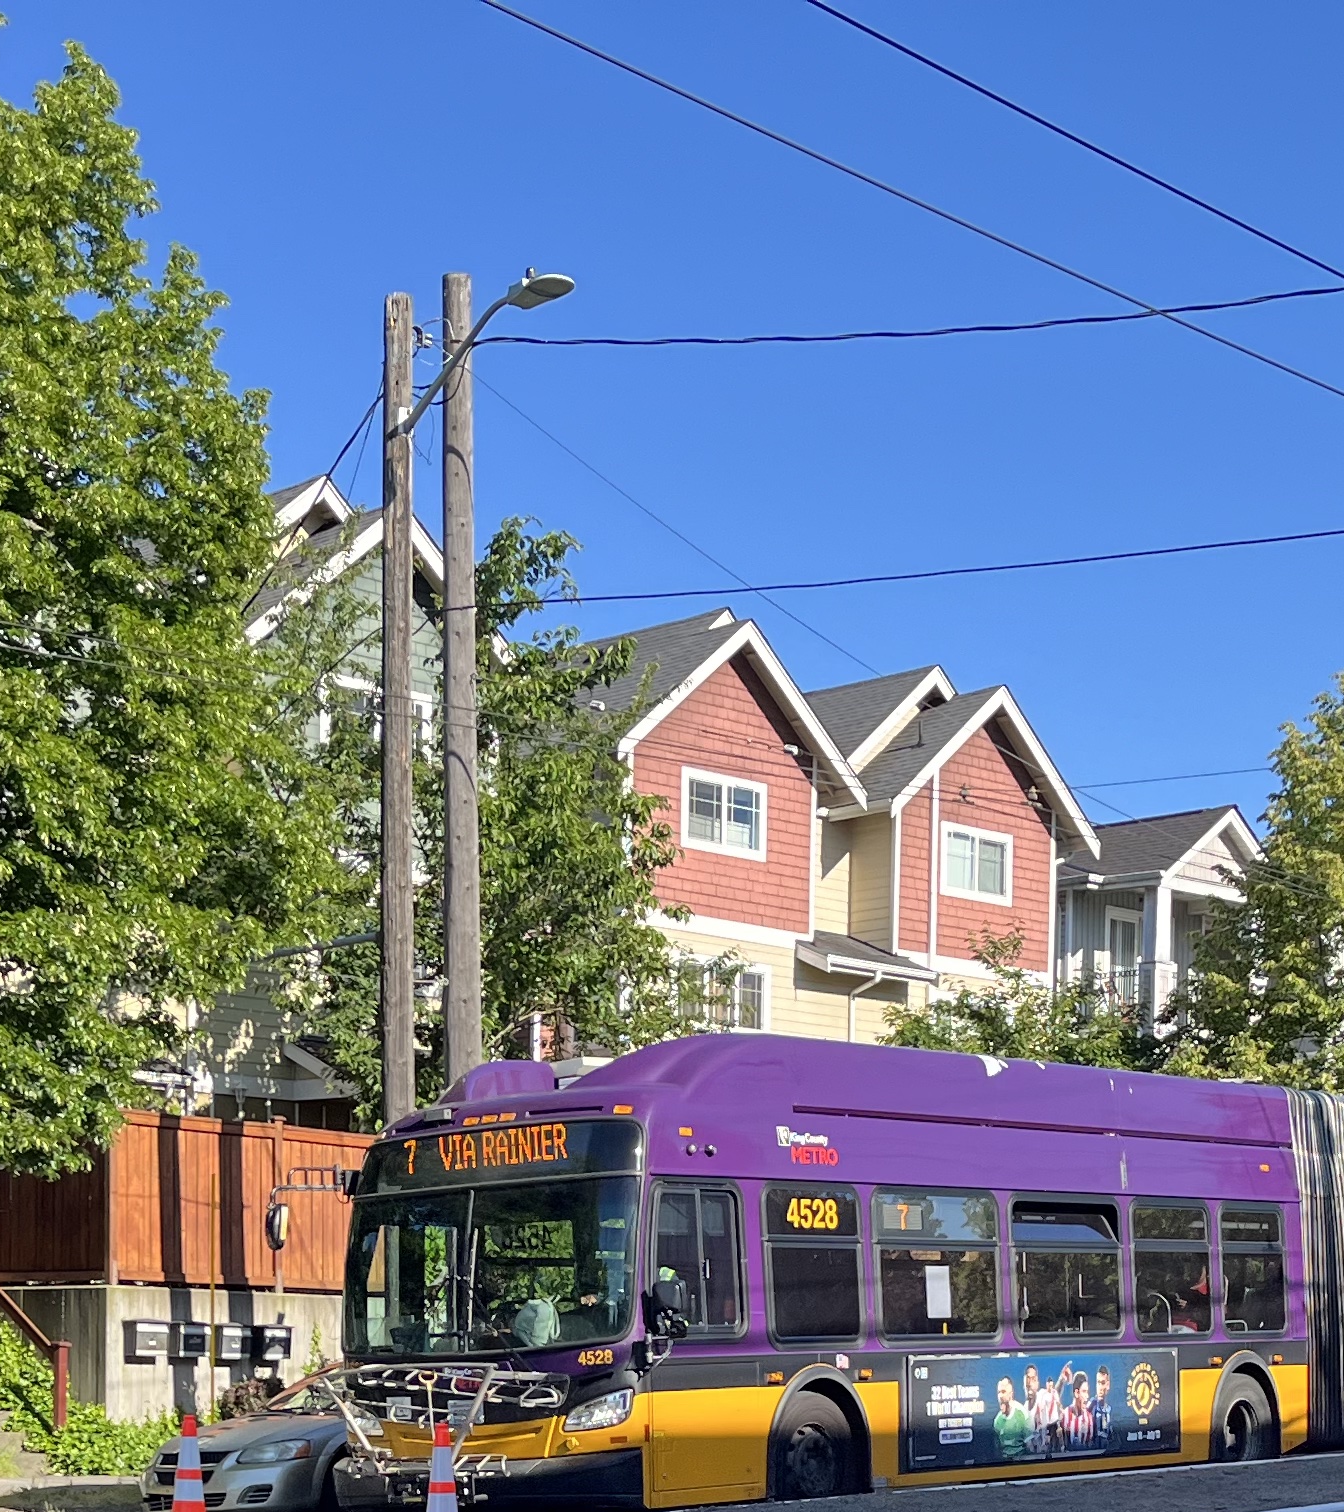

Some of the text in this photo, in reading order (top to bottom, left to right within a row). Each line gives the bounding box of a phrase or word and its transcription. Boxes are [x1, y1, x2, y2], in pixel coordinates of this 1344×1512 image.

[403, 1122, 568, 1175] 7 VIA RAINIER
[790, 1146, 839, 1167] METRO
[786, 1197, 839, 1230] 4528
[896, 1203, 909, 1231] 7
[577, 1349, 614, 1366] 4528
